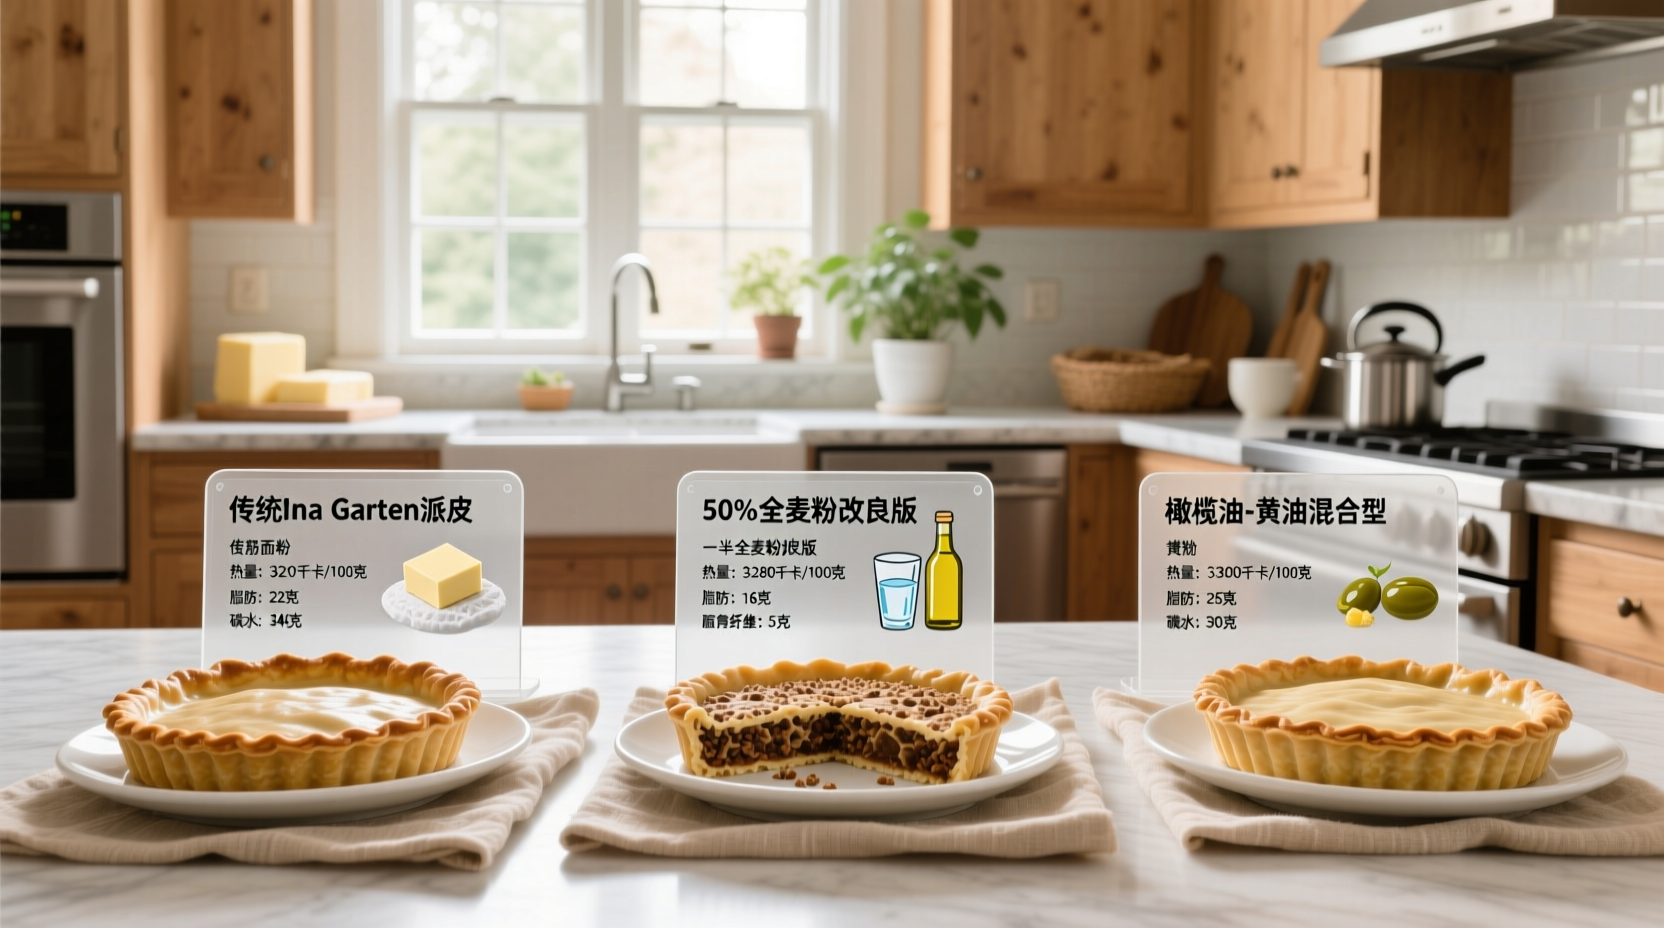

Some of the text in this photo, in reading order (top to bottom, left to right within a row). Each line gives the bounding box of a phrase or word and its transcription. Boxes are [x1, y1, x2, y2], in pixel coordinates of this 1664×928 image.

[229, 495, 473, 524] 传统Ina Garten派皮
[702, 496, 918, 525] 50%全麦粉改良版
[1164, 496, 1387, 525] 橄榄油-黄油混合型
